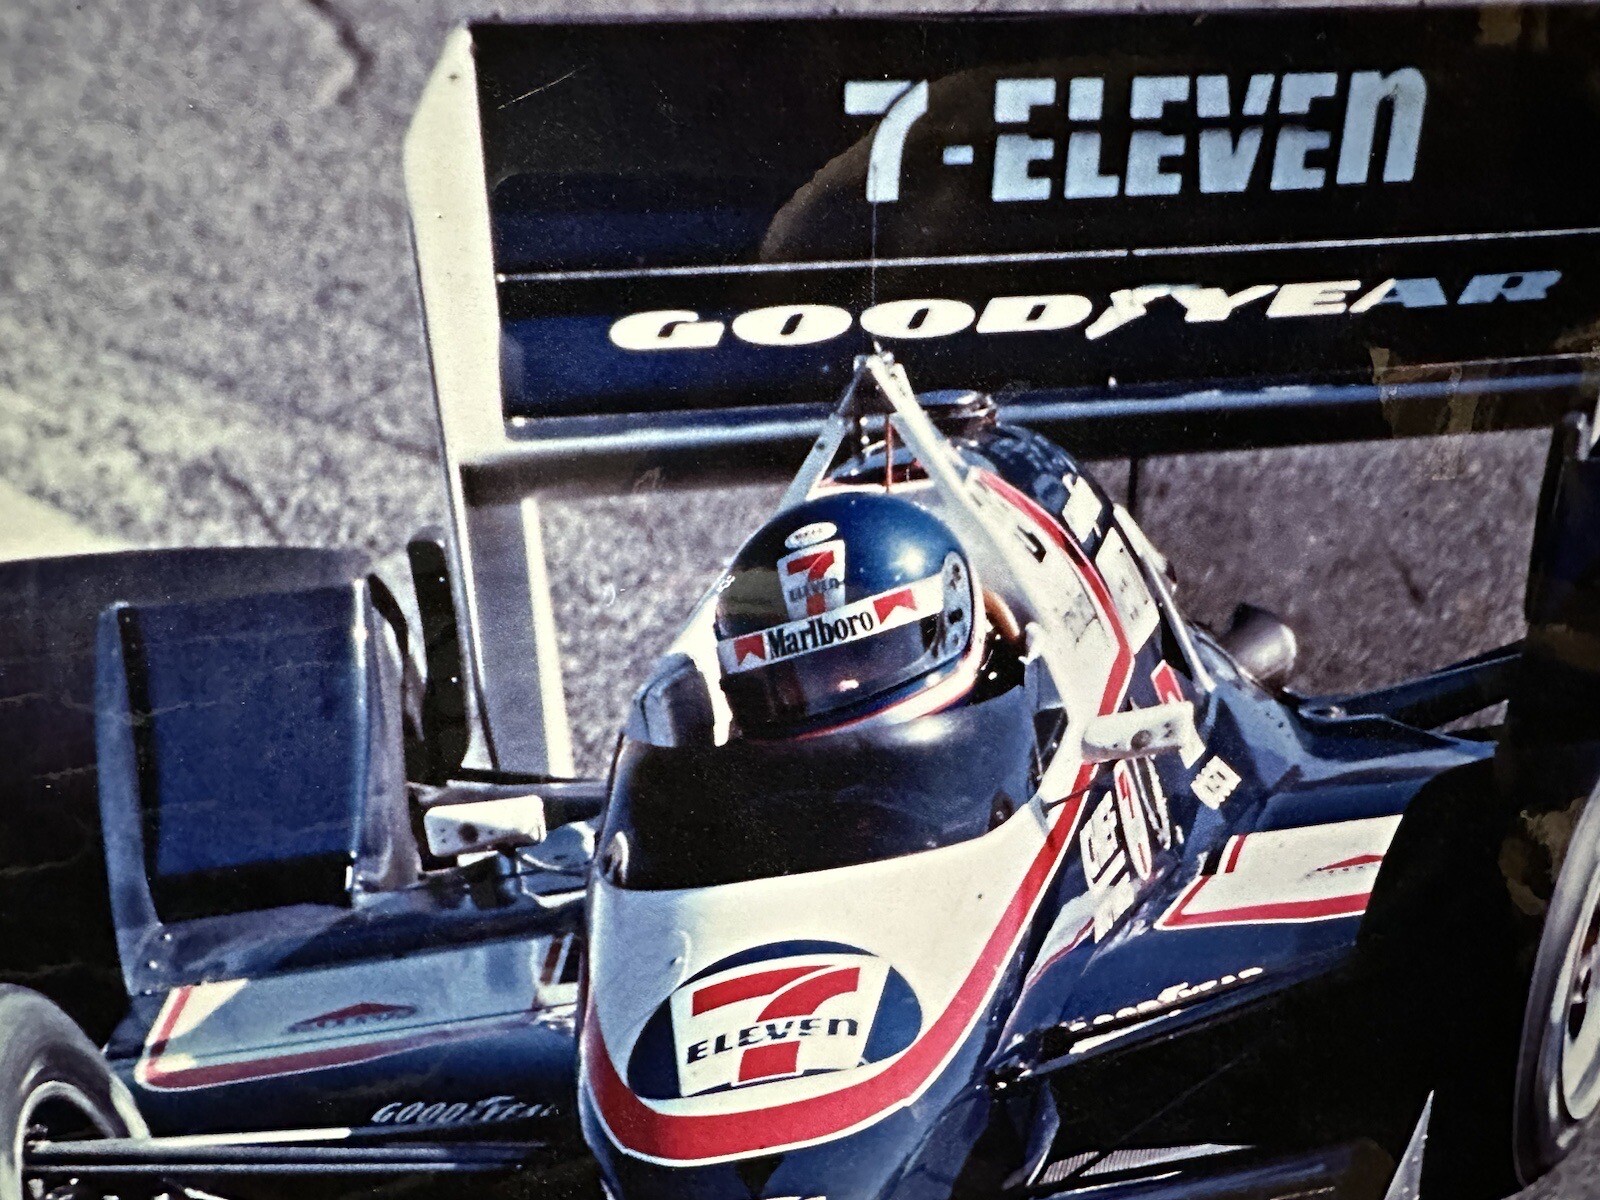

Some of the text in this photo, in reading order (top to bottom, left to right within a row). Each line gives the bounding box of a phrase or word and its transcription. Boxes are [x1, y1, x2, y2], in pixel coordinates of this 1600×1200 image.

[608, 270, 1562, 352] GOODYEAR
[787, 550, 835, 616] 7
[766, 610, 875, 660] Marlboro
[692, 964, 861, 1083] 7
